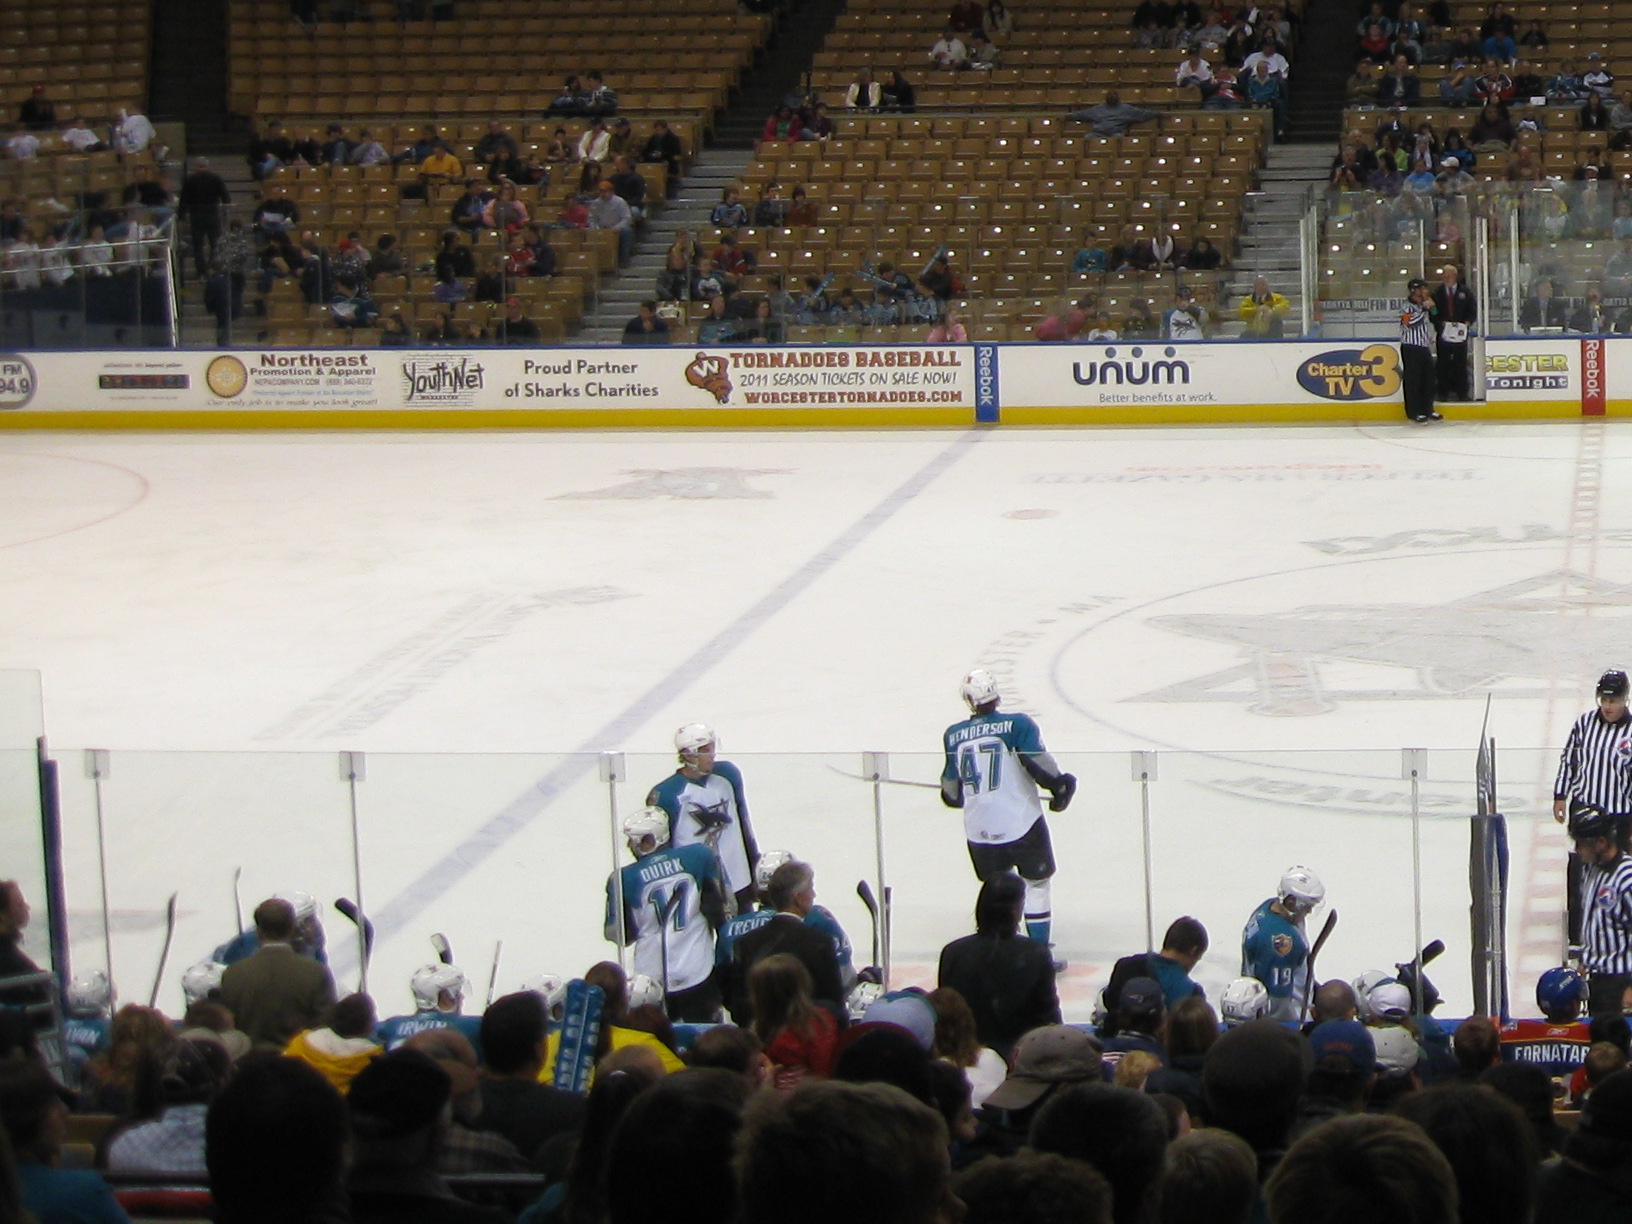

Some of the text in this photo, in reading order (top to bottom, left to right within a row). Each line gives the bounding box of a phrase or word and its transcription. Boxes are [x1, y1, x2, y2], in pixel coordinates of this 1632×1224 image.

[261, 354, 369, 367] Northeast
[525, 360, 638, 374] Proud Partner
[730, 350, 962, 368] TORNADOES BASEBALL
[3, 364, 22, 375] FM
[251, 367, 376, 377] Promotion & Apparel
[979, 345, 994, 406] Reebok
[1073, 353, 1191, 385] unum
[1307, 362, 1371, 378] Charter
[1325, 344, 1400, 397] TV 3
[1585, 339, 1600, 398] Reebok
[403, 358, 485, 401] YouthNet
[740, 371, 957, 387] 2011 SEASON TICKETS ON SALE NOW!
[1487, 377, 1568, 389] Tonight
[505, 382, 659, 397] of Sharks Charities
[744, 390, 962, 405] WORCESTERTORNADOES.COM
[1099, 392, 1217, 403] Better benefits at work.
[950, 720, 1014, 746] HENDERSON
[961, 740, 1003, 794] 47
[1273, 967, 1291, 986] 19
